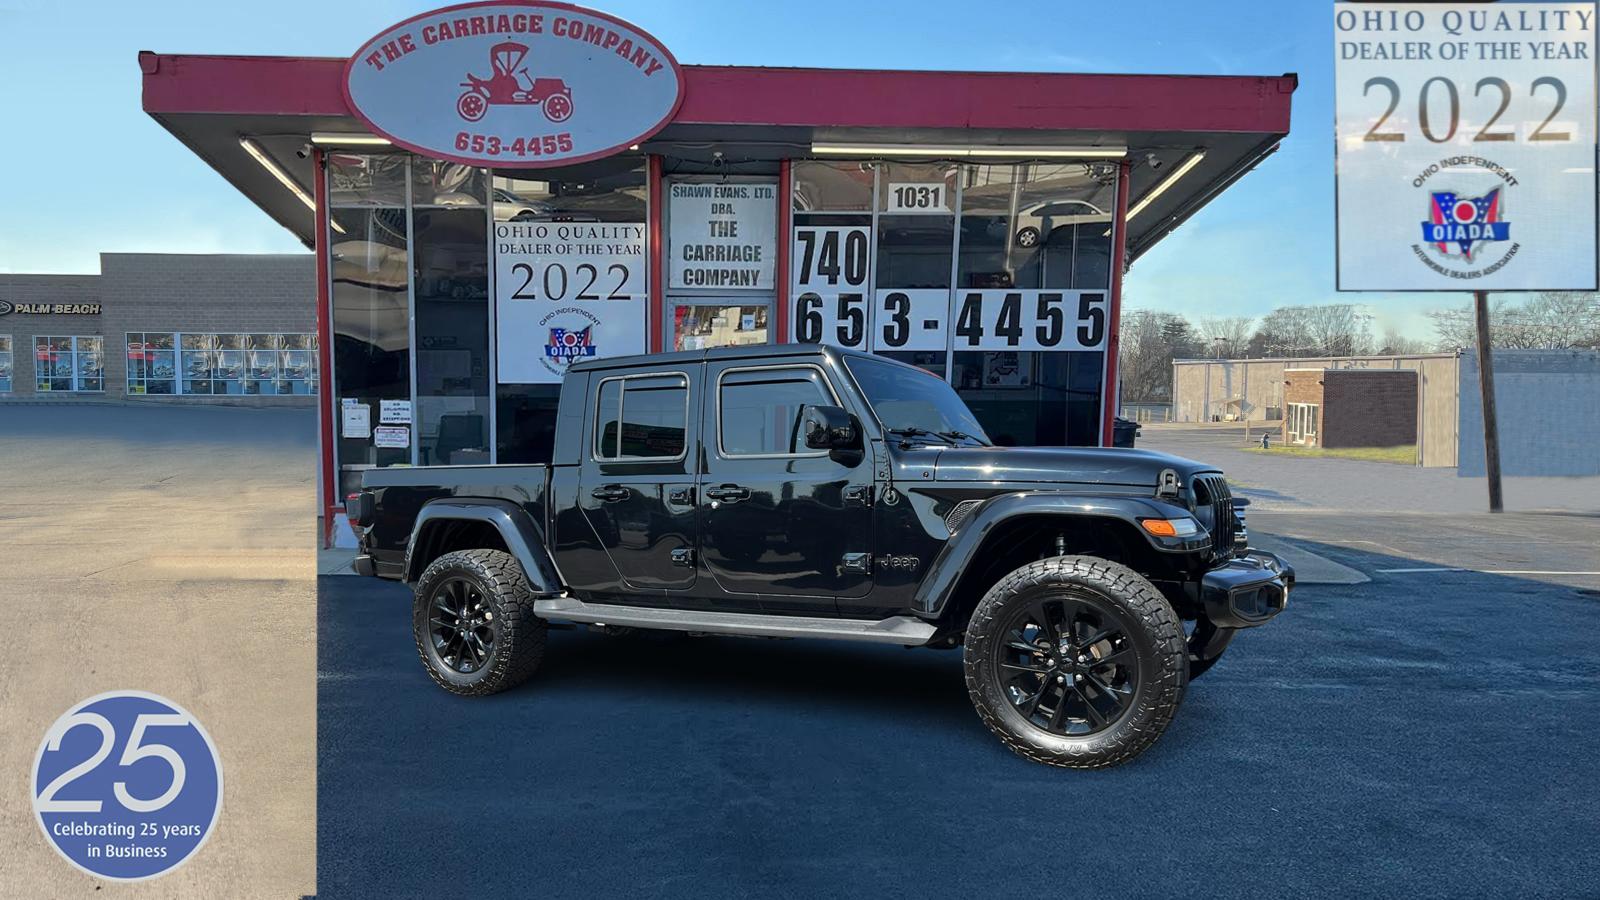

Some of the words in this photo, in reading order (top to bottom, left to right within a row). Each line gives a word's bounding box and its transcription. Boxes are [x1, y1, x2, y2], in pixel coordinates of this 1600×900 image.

[1336, 10, 1425, 31] OHIO
[1442, 10, 1592, 35] QUALITY
[366, 35, 416, 72] THE
[422, 14, 544, 45] CARRIAGE
[552, 17, 664, 77] COMPANY
[1341, 42, 1433, 60] DEALER
[1439, 42, 1469, 60] OF
[1475, 42, 1522, 60] THE
[1528, 42, 1589, 60] YEAR
[1363, 76, 1571, 143] 2022
[454, 132, 573, 157] 653-4455
[1412, 163, 1440, 188] OHIO
[1440, 155, 1519, 188] INDEPENDENT
[672, 185, 712, 199] SHAWN
[753, 186, 775, 200] LTD.
[894, 186, 941, 208] 1031
[710, 203, 736, 215] DBA.
[497, 226, 549, 239] OHIO
[557, 226, 644, 243] QUALITY
[708, 220, 738, 238] THE
[1432, 224, 1496, 241] OIADA
[499, 243, 552, 256] DEALER
[555, 243, 575, 256] OF
[577, 243, 605, 256] THE
[606, 243, 642, 256] YEAR
[682, 244, 762, 263] CARRIAGE
[797, 229, 868, 286] 740
[1411, 243, 1450, 277] AUTOMOBILE
[1449, 269, 1483, 280] DEALERS
[510, 262, 632, 301] 2022
[682, 268, 761, 287] COMPANY
[14, 304, 51, 314] PALM
[54, 304, 101, 314] BEACH
[539, 312, 556, 327] OHIO
[555, 307, 601, 327] INDEPENDENT
[795, 292, 1104, 347] 653-4455
[551, 346, 588, 357] OIADA
[880, 553, 920, 572] Jeep
